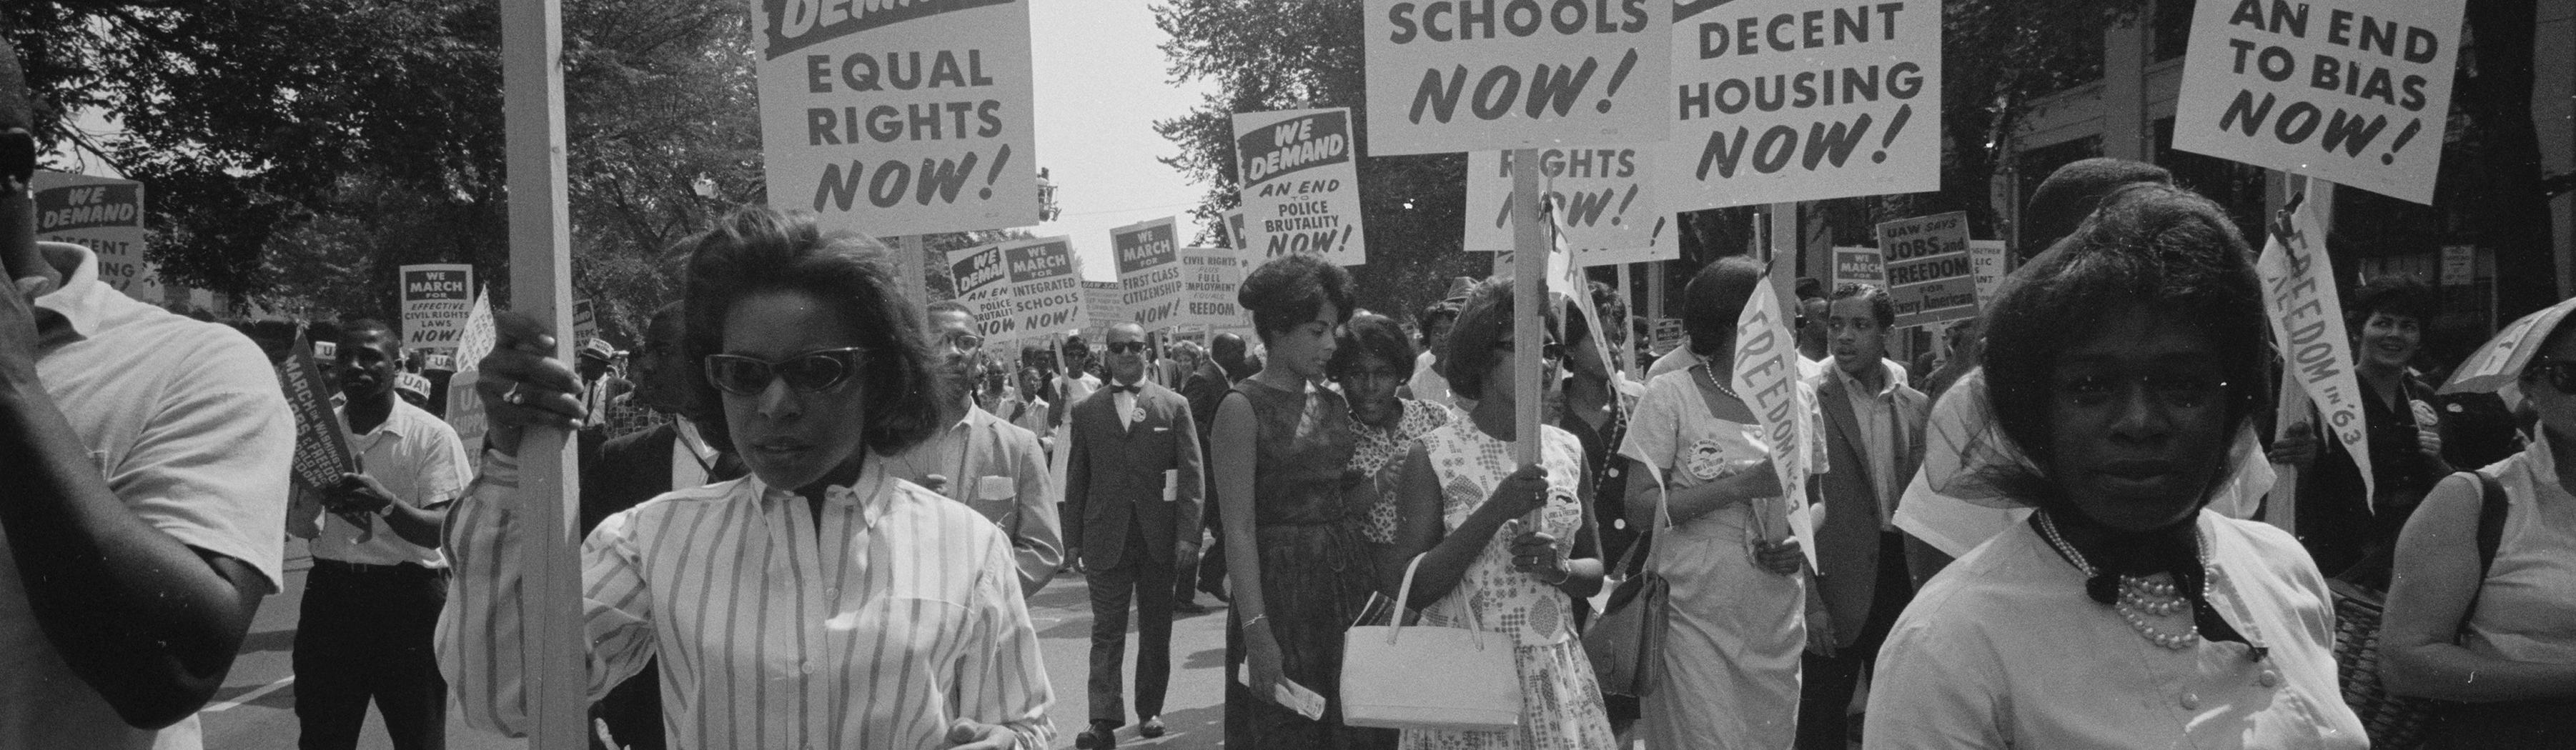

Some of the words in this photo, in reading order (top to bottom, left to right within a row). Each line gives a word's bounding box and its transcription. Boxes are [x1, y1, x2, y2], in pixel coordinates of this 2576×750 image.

[1389, 0, 1648, 44] SCHOOLS
[1699, 2, 1903, 59] DECENT
[2229, 0, 2309, 39] AN
[2327, 9, 2438, 65] END
[807, 49, 993, 94] EQUAL
[2229, 37, 2294, 82] TO
[2310, 54, 2427, 112] BIAS
[1408, 47, 1638, 125] NOW!
[1679, 61, 1923, 120] HOUSING
[807, 99, 1002, 146] RIGHTS
[1274, 118, 1314, 147] WE
[2219, 88, 2421, 166] NOW!
[1695, 103, 1912, 181] NOW!
[1249, 134, 1344, 180] DEMAND
[1500, 149, 1635, 178] RGHTS
[813, 143, 1011, 213] NOW!
[1259, 181, 1292, 197] AN
[1298, 179, 1339, 194] END
[68, 186, 106, 206] WE
[42, 203, 134, 229] DEMAND
[1278, 201, 1328, 217] POLICE
[1265, 215, 1339, 233] BRUTALITY
[1887, 224, 1920, 238] UAW
[1926, 219, 1957, 233] SAYS
[1137, 230, 1153, 244] WE
[1266, 224, 1352, 258] NOW!
[1027, 246, 1047, 257] WE
[1124, 239, 1170, 262] MARCH
[1886, 236, 1940, 261] JOBS
[1943, 236, 1964, 252] and
[973, 249, 996, 270] WE
[1013, 254, 1066, 274] MARCH
[1140, 257, 1158, 267] FOR
[1183, 256, 1204, 266] CIVIL
[1207, 256, 1237, 266] RIGHTS
[1841, 263, 1883, 273] MARCH
[426, 271, 445, 281] WE
[961, 261, 1004, 291] DEMA
[1031, 269, 1052, 278] FOR
[1122, 274, 1149, 291] FIRST
[1151, 266, 1179, 284] CLASS
[1198, 274, 1220, 282] FULL
[1889, 257, 1969, 284] FREEDOM
[410, 281, 462, 292] MARCH
[968, 289, 987, 302] AN
[991, 286, 1008, 297] EN
[1013, 277, 1076, 297] INTEGRATED
[1122, 281, 1182, 305] CITIZENSHIP
[1919, 285, 1943, 294] FOR
[411, 302, 465, 311] EFFECTIVE
[980, 299, 1011, 312] POLICE
[1016, 292, 1079, 312] SCHOOLS
[1134, 297, 1181, 324] NOW!
[1189, 301, 1235, 316] REEDOM
[1893, 299, 1921, 314] Every
[1924, 293, 1973, 309] American
[405, 311, 430, 320] CIVIL
[974, 308, 1013, 322] BRUTALIT
[1026, 306, 1079, 331] NOW!
[412, 328, 464, 343] NOW!
[285, 354, 318, 412] MARCH
[1735, 309, 1795, 461] FREEDOM
[2324, 386, 2340, 404] IN
